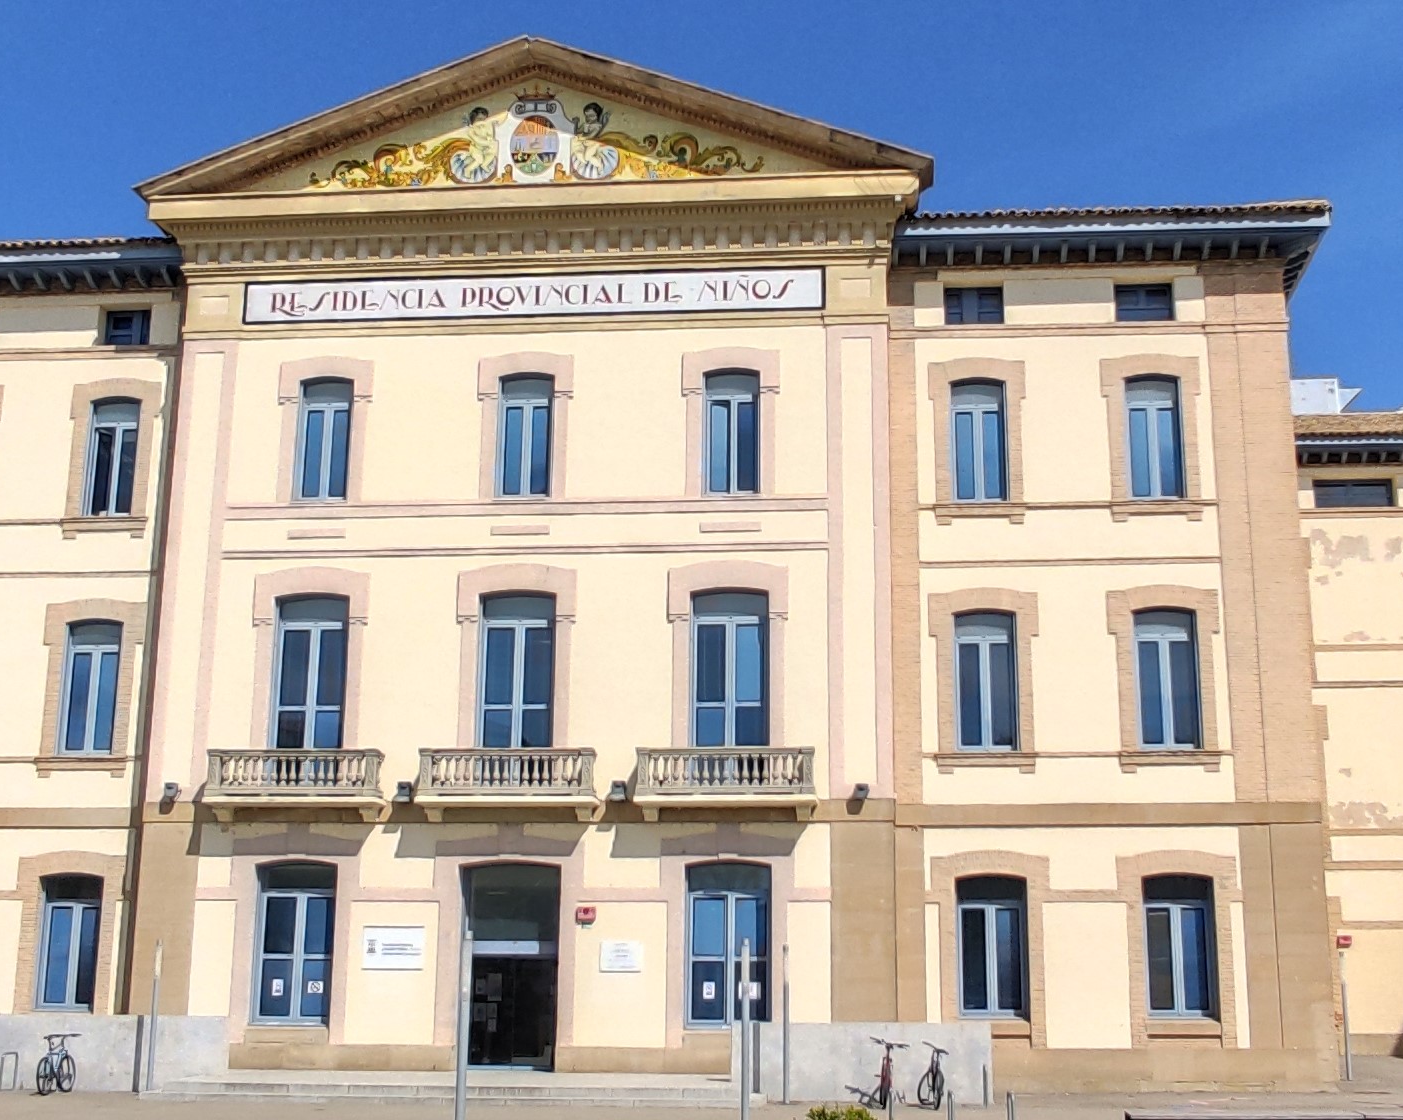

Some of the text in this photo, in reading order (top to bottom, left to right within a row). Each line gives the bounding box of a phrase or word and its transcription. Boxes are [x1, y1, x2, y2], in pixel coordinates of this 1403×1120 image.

[270, 275, 795, 317] RESIDENCIA PROVINCIAL DE NIÑOS
